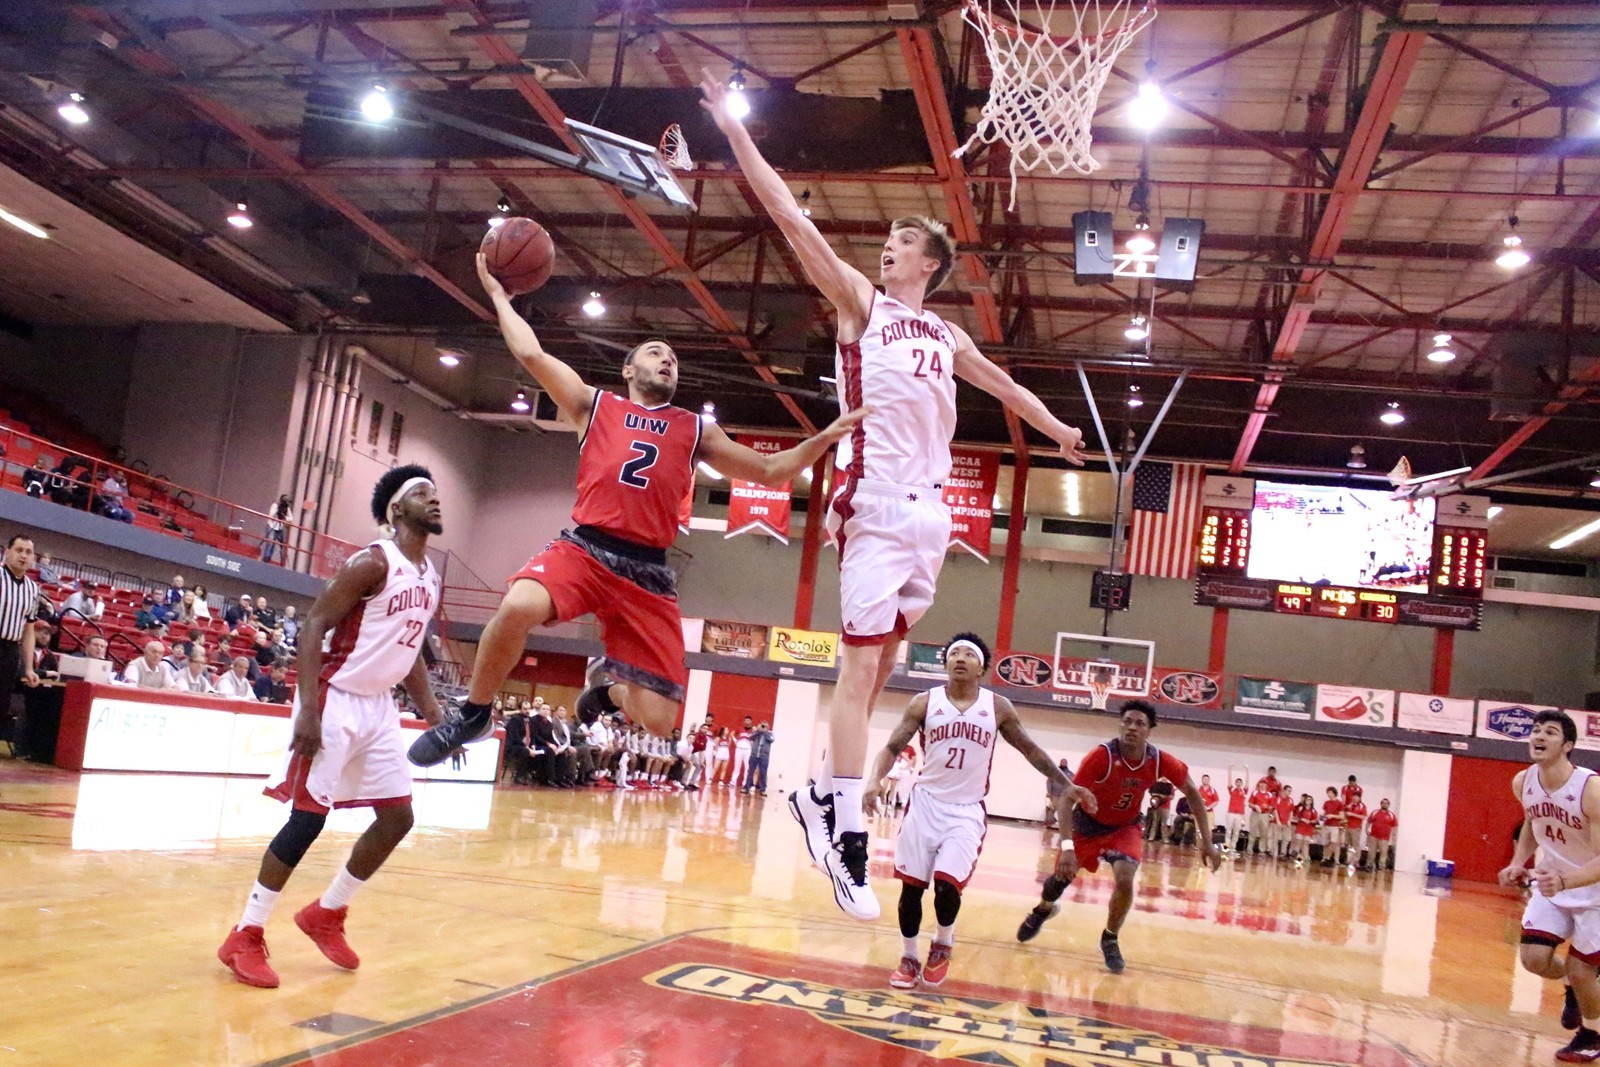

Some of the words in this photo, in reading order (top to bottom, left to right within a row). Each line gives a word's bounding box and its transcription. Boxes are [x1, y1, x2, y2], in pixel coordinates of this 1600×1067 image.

[912, 348, 943, 380] 24
[624, 412, 669, 436] UIW
[753, 441, 781, 451] NCAA
[619, 440, 659, 489] 2
[951, 456, 981, 467] NCAA
[951, 467, 980, 477] WEST
[944, 478, 984, 489] REGION
[732, 487, 790, 501] CHAMPIONS
[749, 505, 769, 516] 1979
[951, 522, 969, 533] 998
[206, 554, 227, 569] SOUTH
[227, 560, 241, 572] SIDE
[1283, 597, 1301, 609] 49
[1338, 606, 1347, 616] 2
[1377, 605, 1394, 618] 30
[397, 619, 424, 649] 22
[774, 631, 832, 654] Rotolo's
[1051, 693, 1073, 703] WEST
[1075, 696, 1091, 705] END
[1491, 713, 1534, 726] Hampto
[929, 721, 991, 748] COLONELS
[1502, 723, 1530, 735] Inn
[945, 747, 966, 770] 21
[1111, 793, 1134, 811] 3
[1545, 824, 1566, 845] 44
[672, 966, 1352, 1067] OUTHLAND
